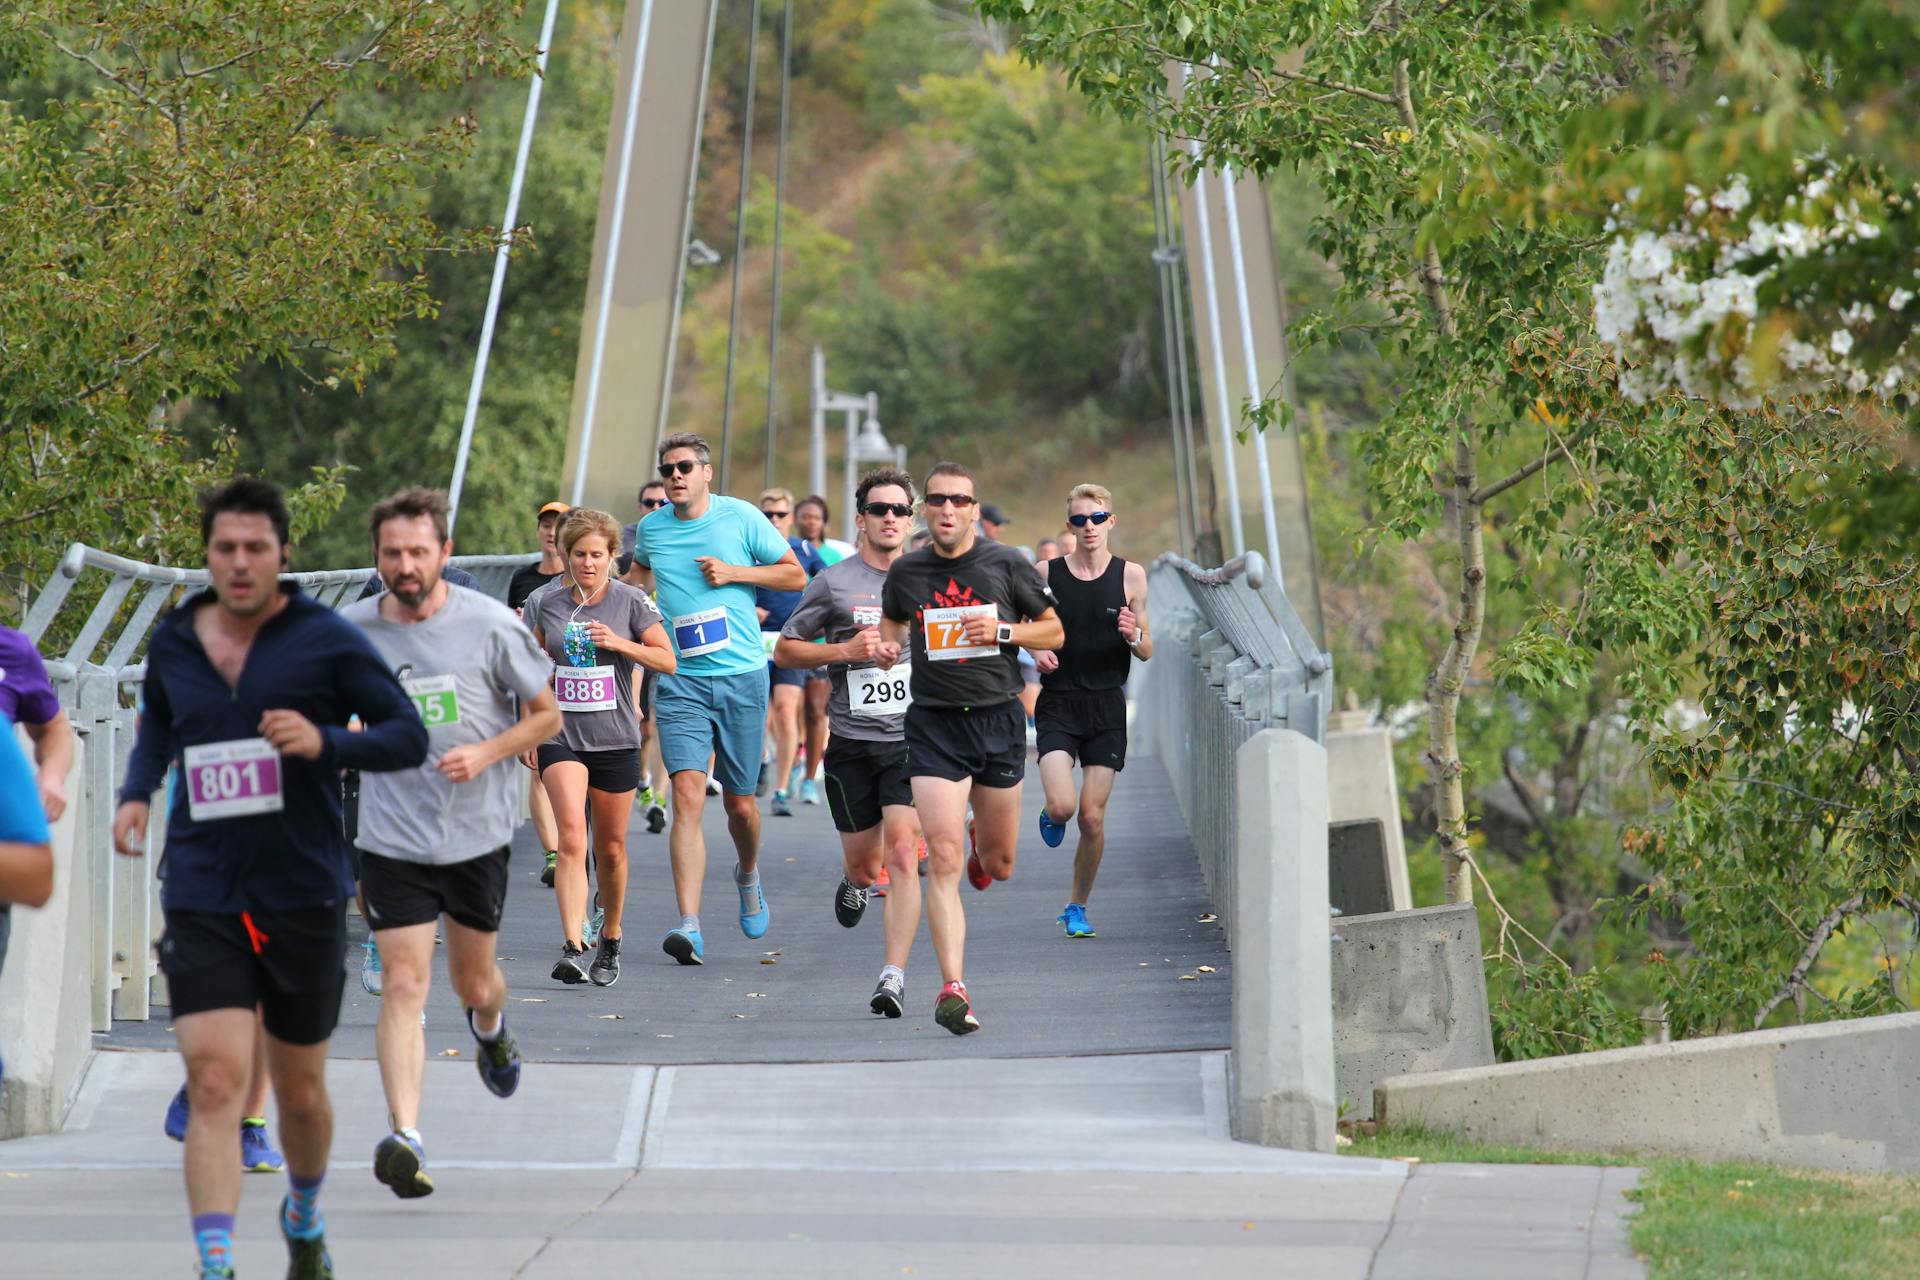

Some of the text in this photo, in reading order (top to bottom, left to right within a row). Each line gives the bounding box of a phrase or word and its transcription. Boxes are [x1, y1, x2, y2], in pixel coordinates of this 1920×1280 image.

[694, 624, 706, 644] 1
[564, 679, 605, 701] 888
[861, 680, 906, 705] 298
[200, 761, 260, 801] 801
